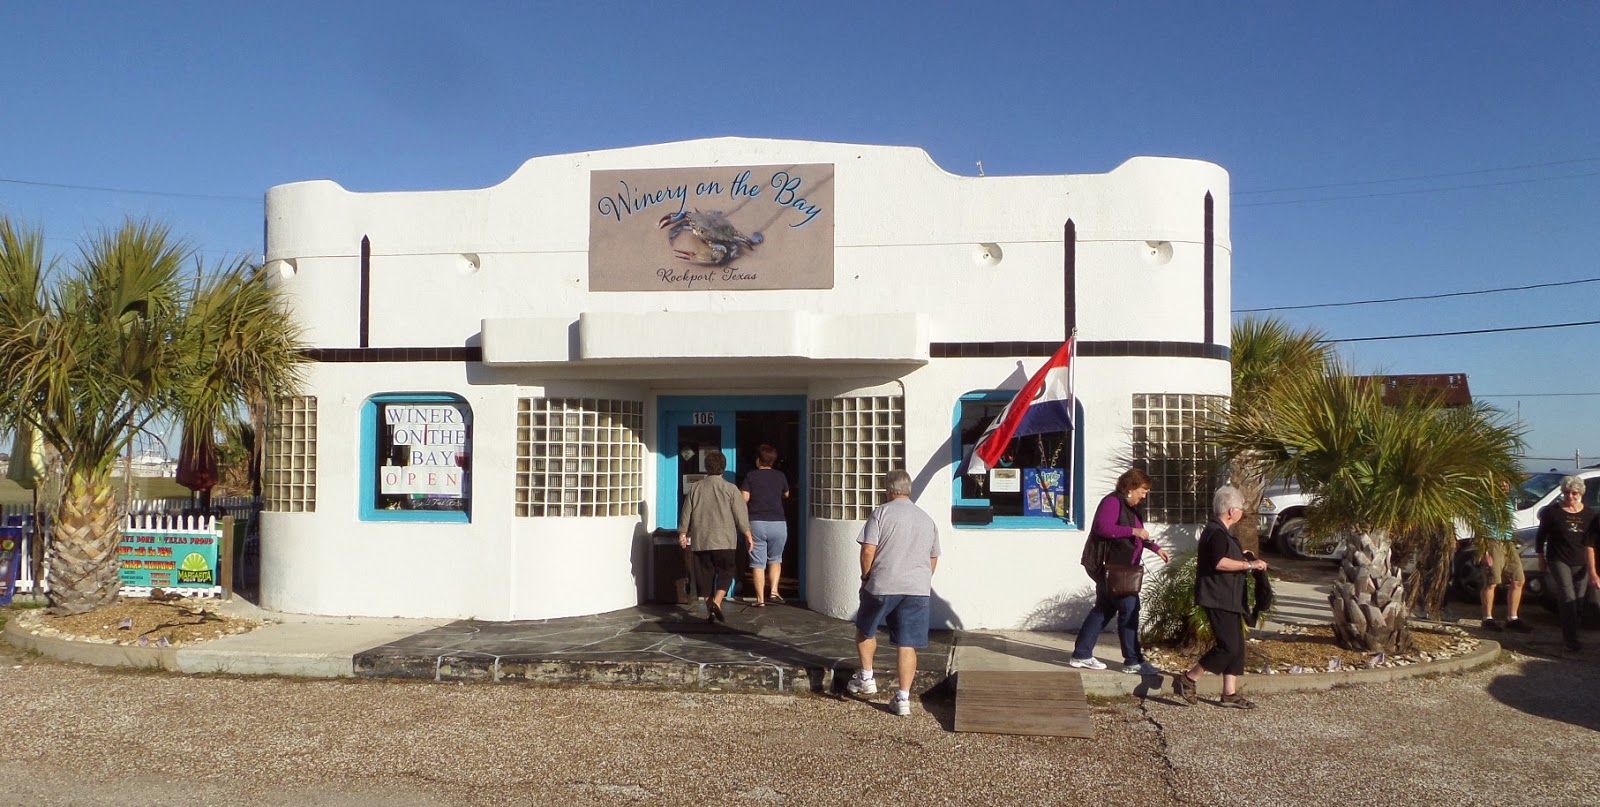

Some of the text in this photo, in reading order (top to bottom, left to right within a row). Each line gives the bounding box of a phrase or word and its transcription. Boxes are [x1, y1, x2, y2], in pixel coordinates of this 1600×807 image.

[598, 169, 822, 228] Winery on the Bay
[722, 266, 757, 281] Texas
[387, 408, 470, 423] WINERY
[694, 412, 714, 425] 106
[395, 429, 466, 444] ON THE
[412, 450, 454, 465] BAY
[386, 472, 458, 486] OPEN
[164, 536, 187, 544] TEXAS
[190, 537, 214, 545] PROUD
[178, 570, 212, 581] MARGARITA
